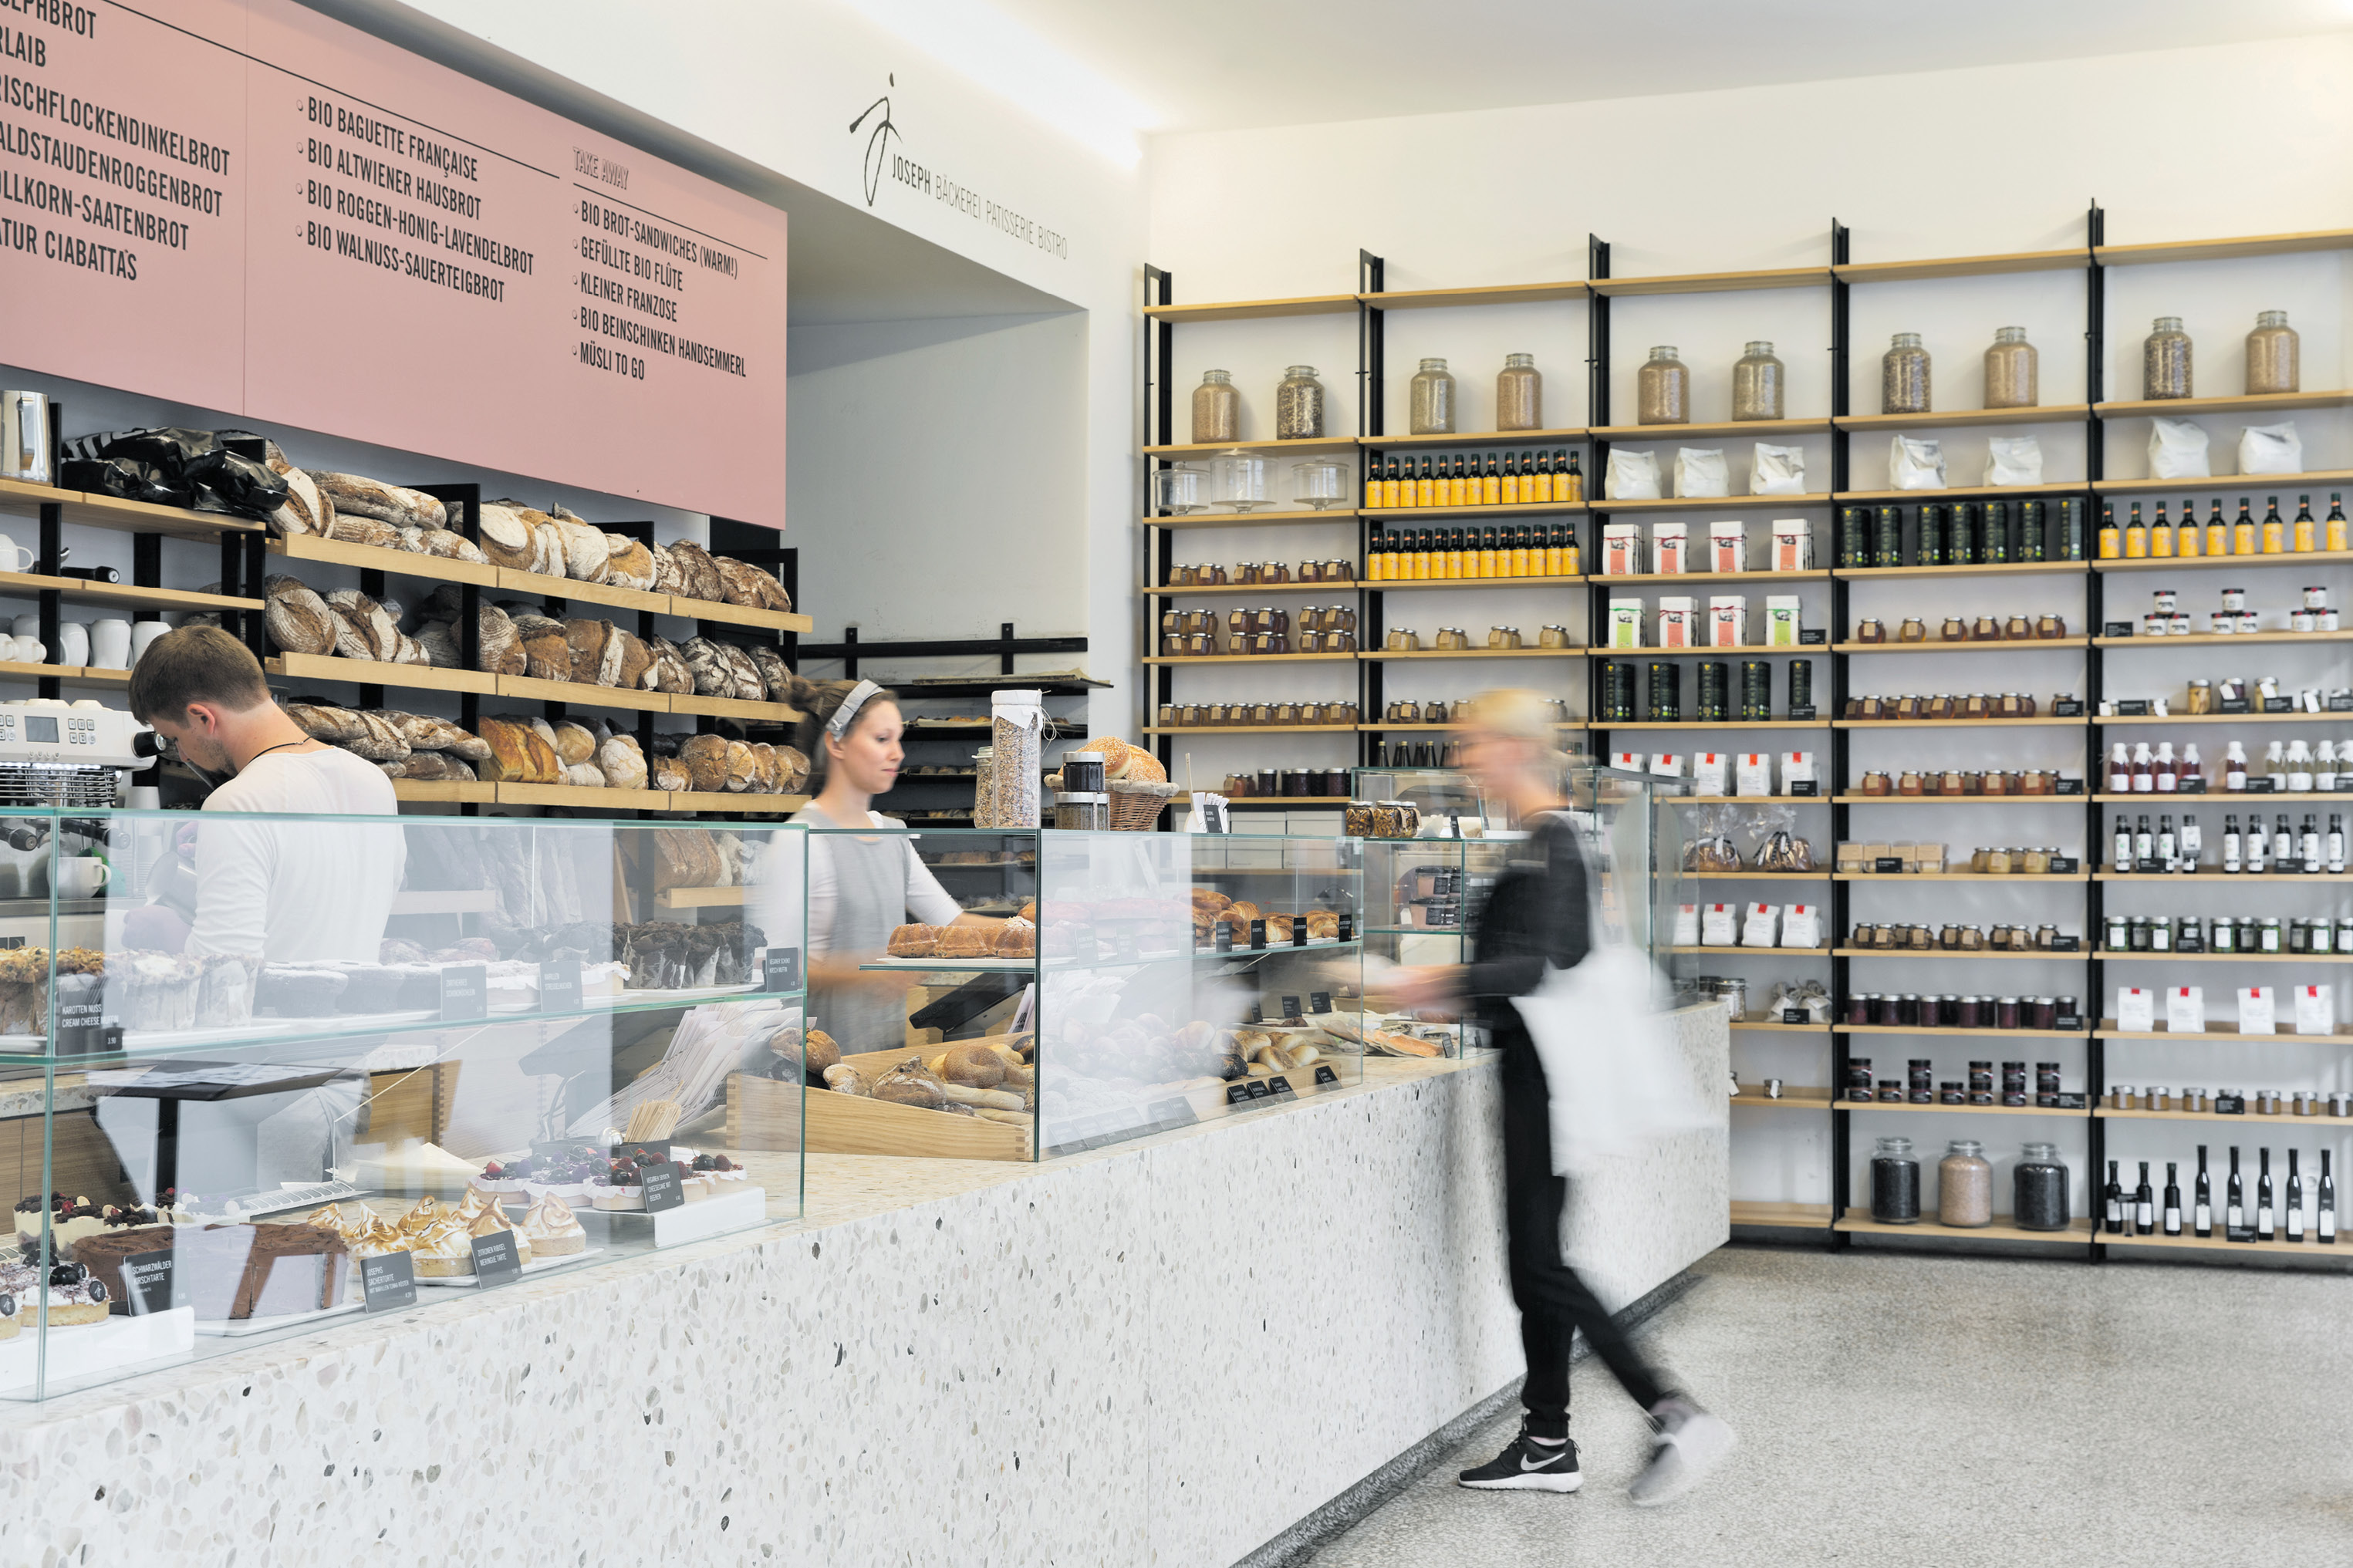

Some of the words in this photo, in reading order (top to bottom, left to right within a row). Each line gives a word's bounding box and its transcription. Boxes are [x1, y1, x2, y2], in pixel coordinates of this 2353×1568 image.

[0, 74, 230, 176] ISCHFLOCKENDINKELBROT
[309, 96, 333, 128] BIO
[338, 106, 404, 155] BAGUETTE
[409, 134, 478, 183] FRANÇAISE
[309, 137, 332, 169] BIO
[336, 148, 411, 197] ALTWIENER
[417, 176, 481, 221] HAUSBROT
[573, 146, 599, 179] TAKE
[601, 157, 630, 191] AWAY
[0, 170, 189, 251] LLKORN-SAATENBROT
[308, 178, 332, 210] BIO
[337, 188, 534, 276] ROGGEN-HONIG-LAVENDELBROT
[893, 153, 931, 195] JOSEPH
[936, 174, 981, 221] BÄCKEREI
[987, 199, 1034, 245] PATISSERIE
[1038, 225, 1068, 261] BISTRO
[0, 217, 37, 255] TUR
[308, 220, 331, 251] BIO
[336, 228, 505, 303] WALNUSS-SAUERTEIGBROT
[582, 200, 599, 227] BIO
[603, 208, 697, 263] BROT-SANDWICHES
[700, 245, 738, 280] (WARM!)
[581, 235, 630, 274] GEFÜLLTE
[634, 255, 651, 281] BIO
[655, 261, 683, 292] FLÛTE
[581, 271, 623, 305] KLEINER
[627, 287, 677, 322] FRANZOSE
[580, 340, 612, 372] MÜSLI
[615, 351, 628, 376] TO
[631, 356, 645, 381] GO
[581, 305, 599, 332] BIO
[603, 312, 675, 356] BEINSCHINKEN
[678, 337, 746, 377] HANDSEMMERL
[62, 1005, 88, 1016] KAROTTEN
[88, 1003, 102, 1013] NUSS
[62, 1017, 79, 1028] CREAM
[80, 1016, 100, 1027] CHEESE
[101, 1015, 119, 1025] MUFFIN
[132, 1260, 173, 1275] SCHWARZWÄLDER
[366, 1266, 383, 1277] JOSEPHS
[478, 1246, 494, 1257] ZITRONEN
[493, 1243, 506, 1253] RIBISEL
[479, 1256, 498, 1266] MERINGUE
[496, 1253, 507, 1262] TARTE
[368, 1273, 395, 1286] SACHERTORTE
